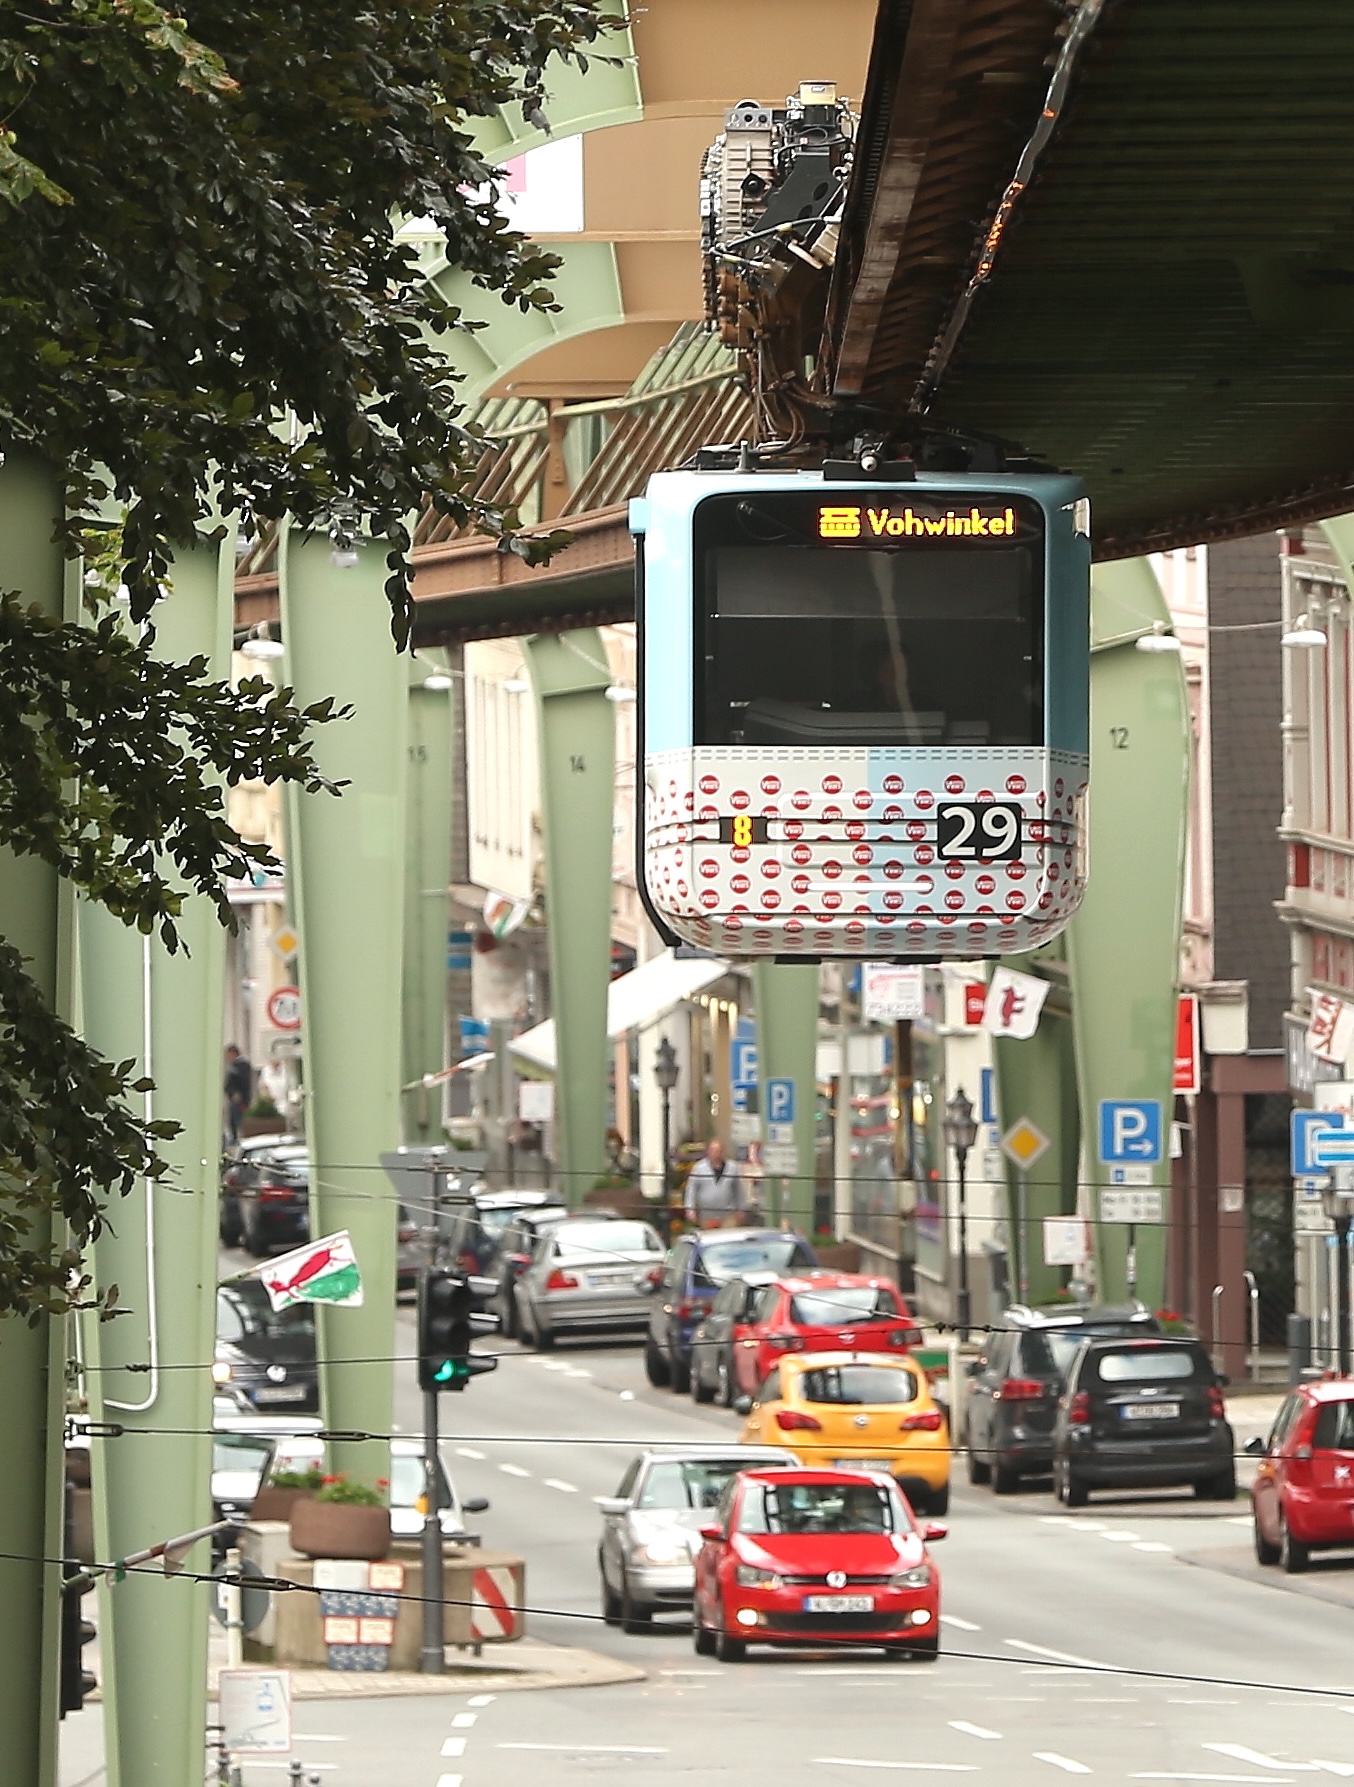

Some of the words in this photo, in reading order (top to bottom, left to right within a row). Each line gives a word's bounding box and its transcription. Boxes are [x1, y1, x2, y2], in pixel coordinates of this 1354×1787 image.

[866, 507, 1016, 537] Vohwinkel
[1109, 727, 1128, 749] 12
[569, 755, 586, 773] 14
[941, 806, 1018, 857] 29
[1113, 1108, 1148, 1155] P
